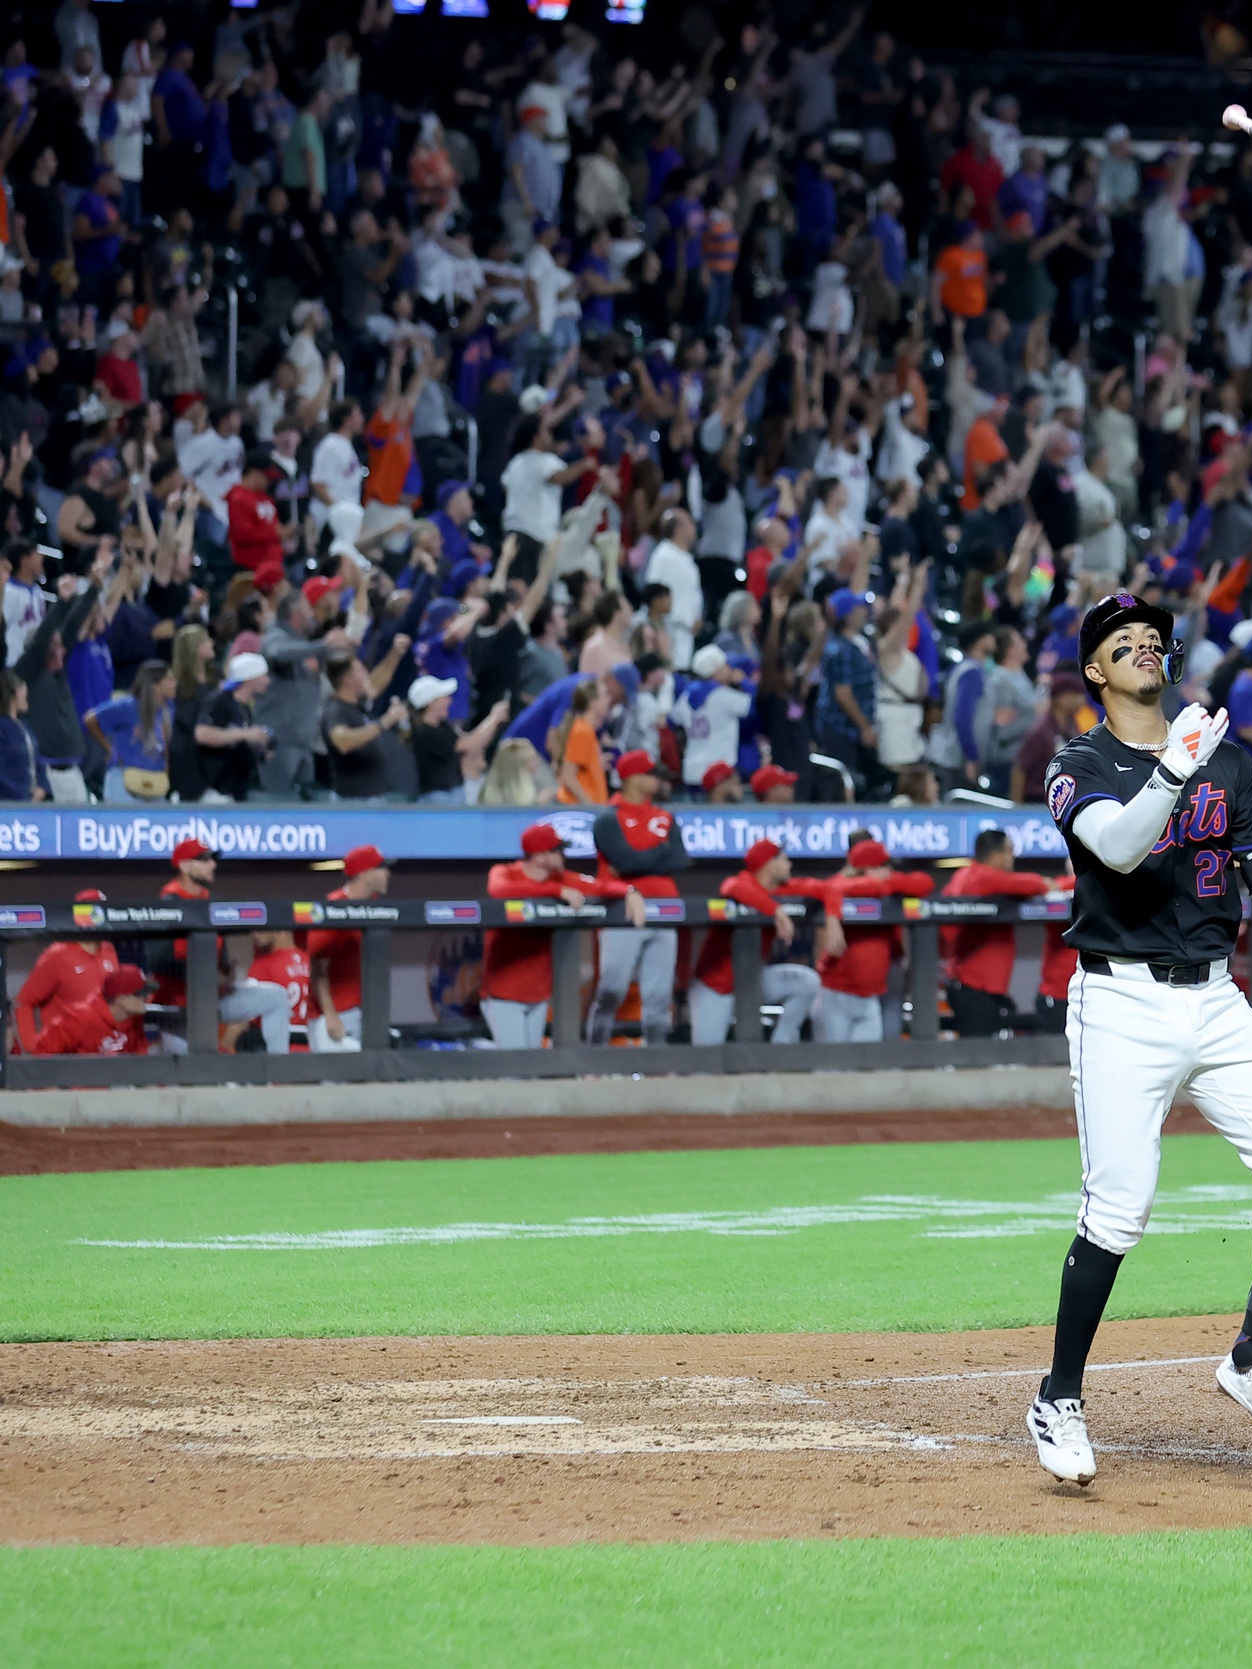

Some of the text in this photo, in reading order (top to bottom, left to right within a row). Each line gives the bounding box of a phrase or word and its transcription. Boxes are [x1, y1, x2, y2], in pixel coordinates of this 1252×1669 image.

[78, 816, 327, 858] BuyFordNow.com
[806, 817, 836, 851] of
[886, 818, 950, 852] Mets
[1151, 781, 1228, 854] ets
[1194, 849, 1232, 898] 27
